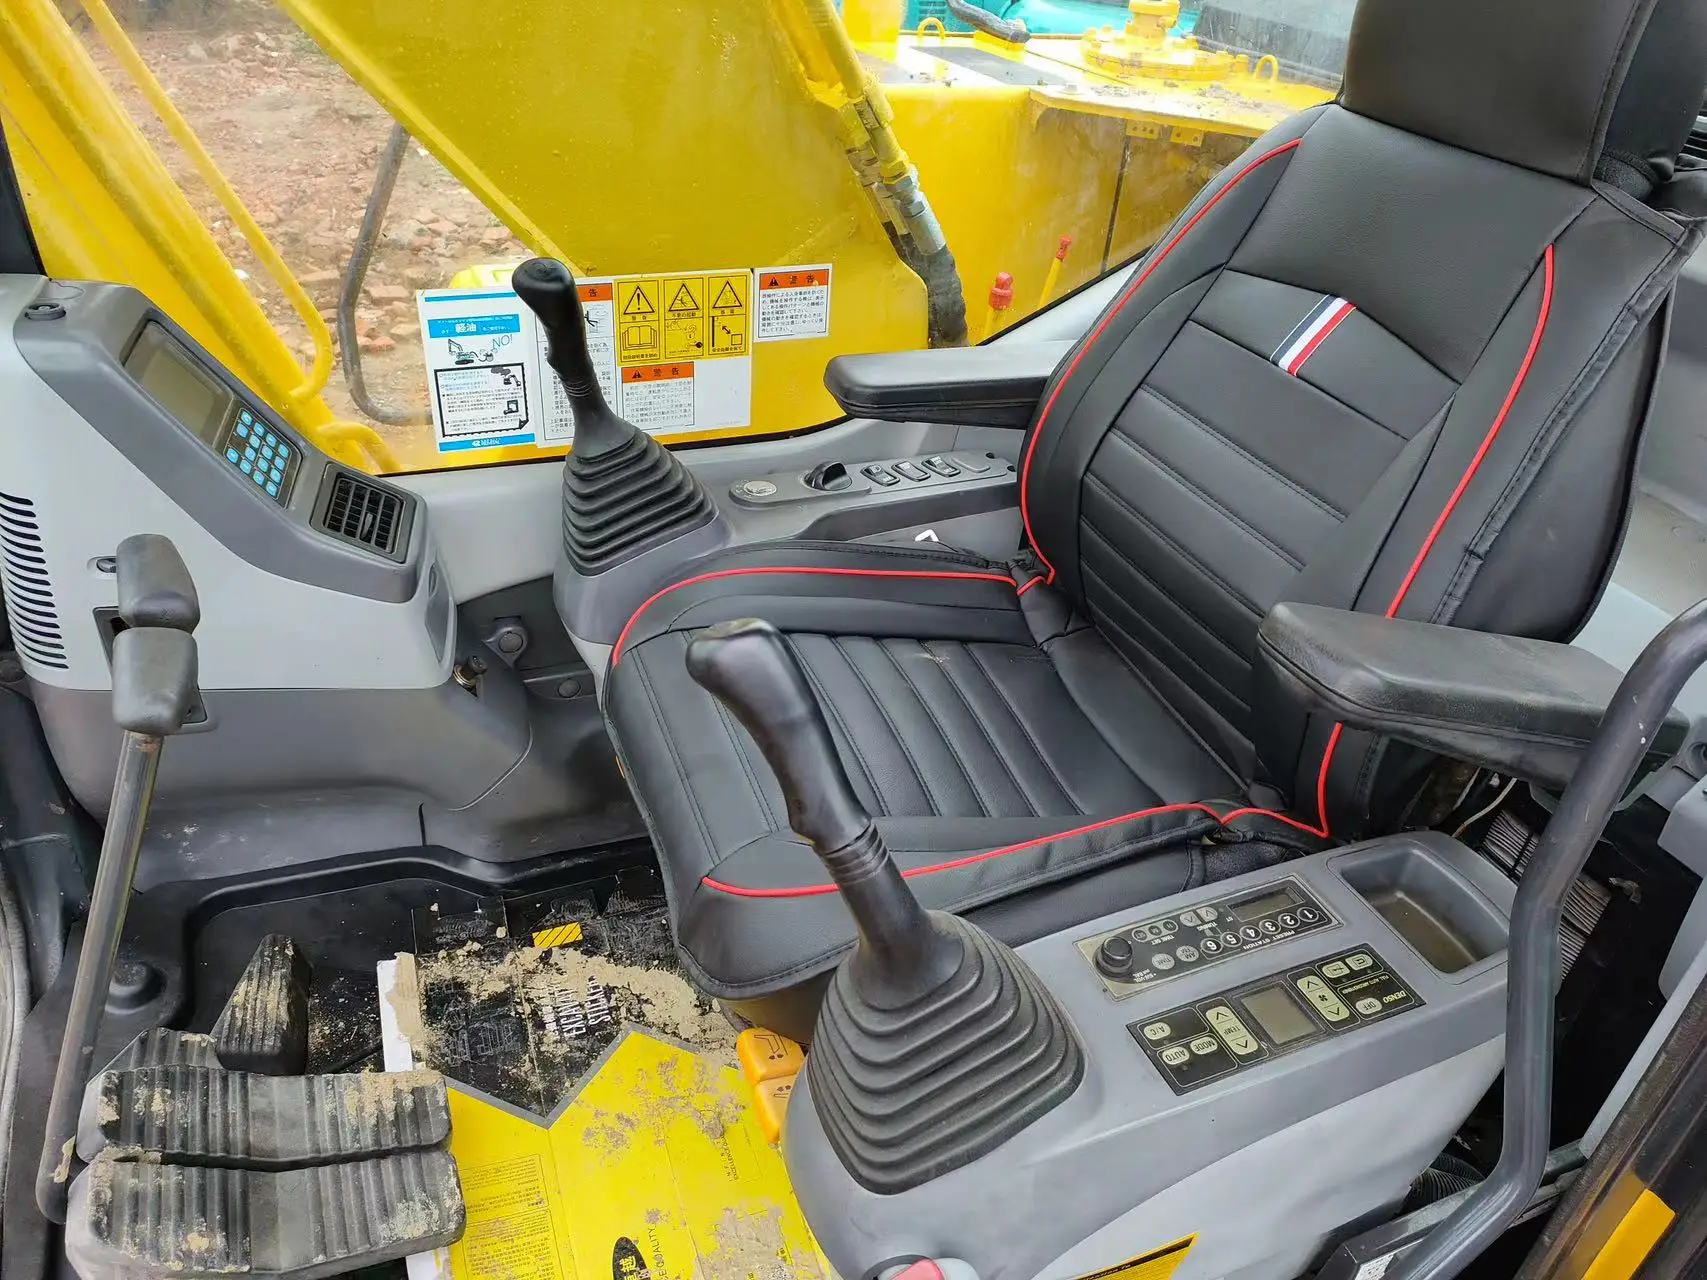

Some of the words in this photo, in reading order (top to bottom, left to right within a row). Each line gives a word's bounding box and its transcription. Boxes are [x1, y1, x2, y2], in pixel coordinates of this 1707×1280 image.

[492, 334, 513, 349] NO!
[1304, 909, 1314, 919] 1
[1283, 915, 1295, 925] 2
[1264, 921, 1276, 931] 3
[1246, 928, 1256, 937] 4
[1272, 930, 1296, 940] PRESET
[1226, 934, 1237, 944] 5
[1243, 938, 1271, 949] STATION
[1206, 941, 1218, 950] 6
[1382, 990, 1407, 1004] DENSO
[1363, 1001, 1377, 1011] OFF
[1149, 1025, 1165, 1036] A/C
[1223, 1025, 1241, 1036] TEMP
[1194, 1039, 1215, 1052] MODE
[1165, 1049, 1187, 1062] AUTO
